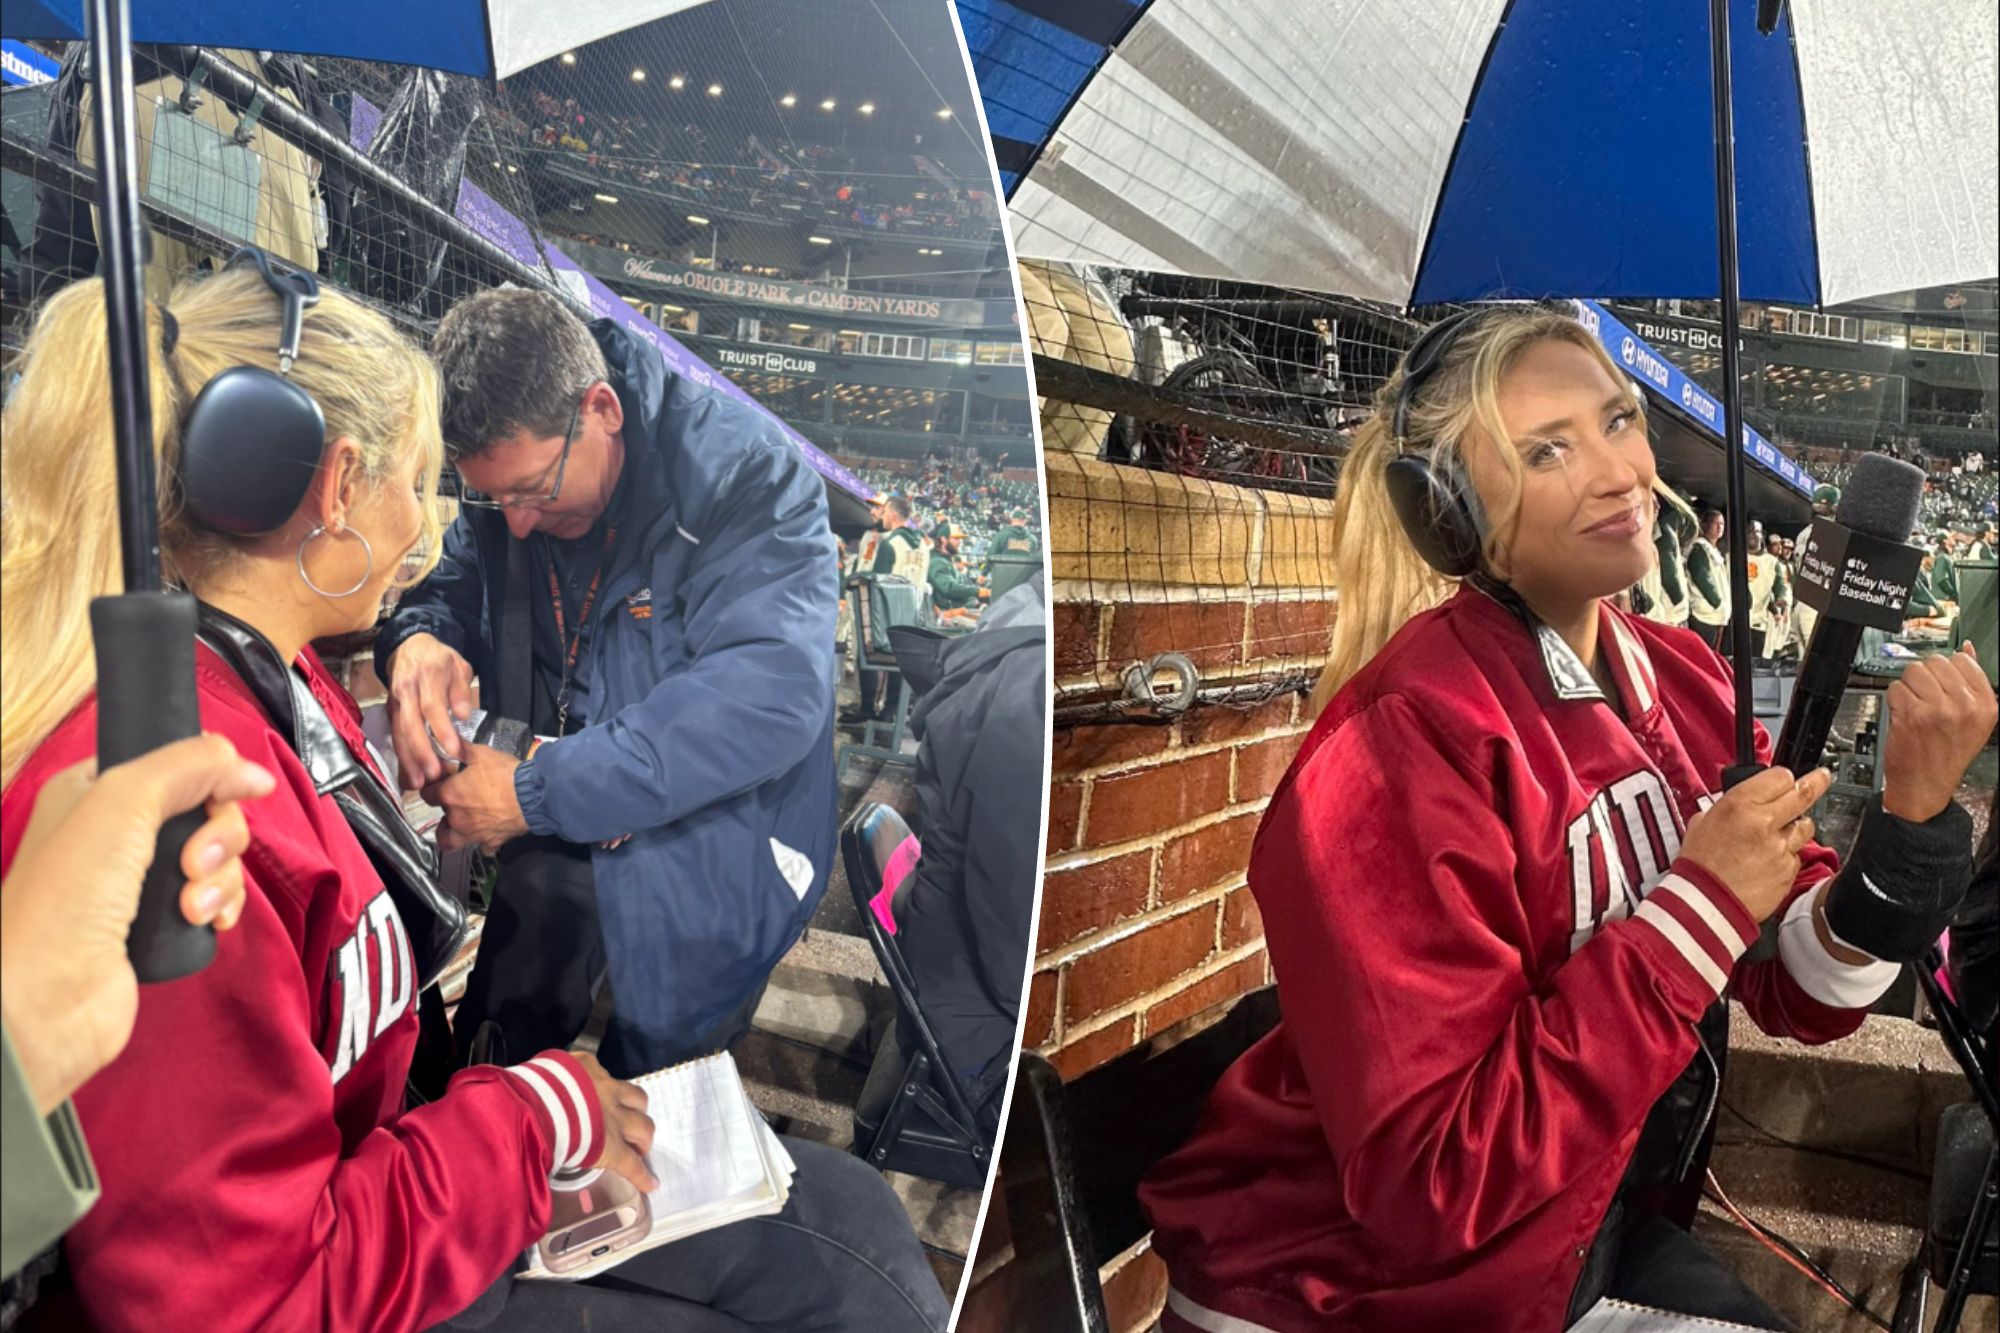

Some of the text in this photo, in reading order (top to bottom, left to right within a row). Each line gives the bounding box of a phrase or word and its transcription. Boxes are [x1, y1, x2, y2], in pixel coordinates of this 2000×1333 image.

[624, 258, 672, 284] Welcome
[672, 274, 682, 286] to
[683, 271, 746, 297] ORIOLE
[746, 281, 790, 303] PARK
[808, 290, 881, 313] CAMDEN
[884, 299, 940, 318] YARDS
[1635, 323, 1687, 342] TRUIST
[718, 349, 816, 373] TRUIST CLUB
[1839, 584, 1886, 606] Baseball
[1843, 570, 1907, 597] Friday Night
